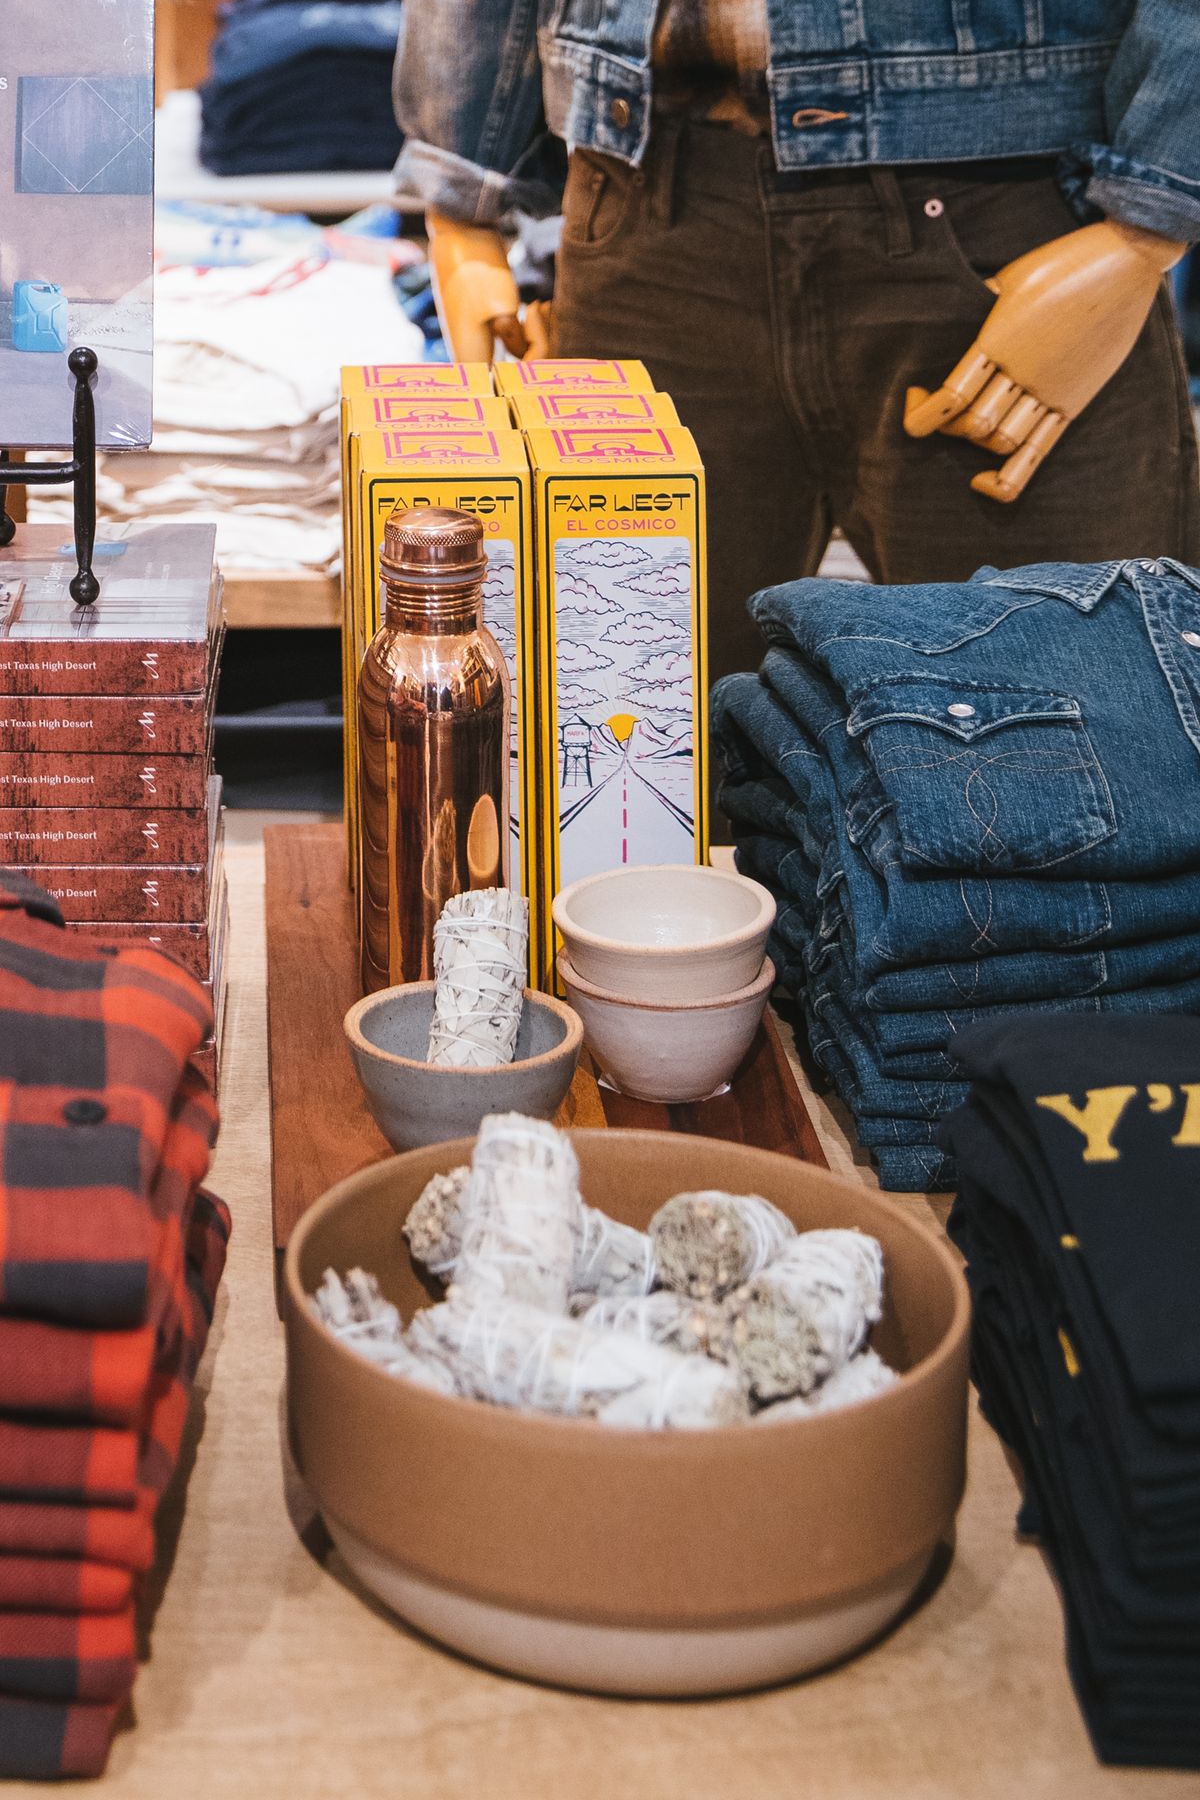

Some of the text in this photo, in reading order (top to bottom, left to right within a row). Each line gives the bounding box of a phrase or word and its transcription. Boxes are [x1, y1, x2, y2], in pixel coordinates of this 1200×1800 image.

[544, 418, 656, 426] COSMICO
[385, 457, 501, 466] COSMICO
[560, 456, 676, 464] COSMICO
[554, 493, 691, 512] FAR WEST
[567, 518, 677, 531] EL COSMICO
[14, 661, 40, 670] Texas
[42, 661, 64, 672] High
[65, 661, 97, 670] Desert
[10, 718, 37, 728] Texas
[38, 718, 60, 730] High
[62, 718, 94, 728] Desert
[11, 774, 38, 784] Texas
[40, 774, 62, 786] High
[63, 774, 95, 784] Desert
[14, 831, 40, 840] Texas
[42, 831, 64, 842] High
[66, 831, 98, 840] Desert
[66, 888, 97, 897] Desert
